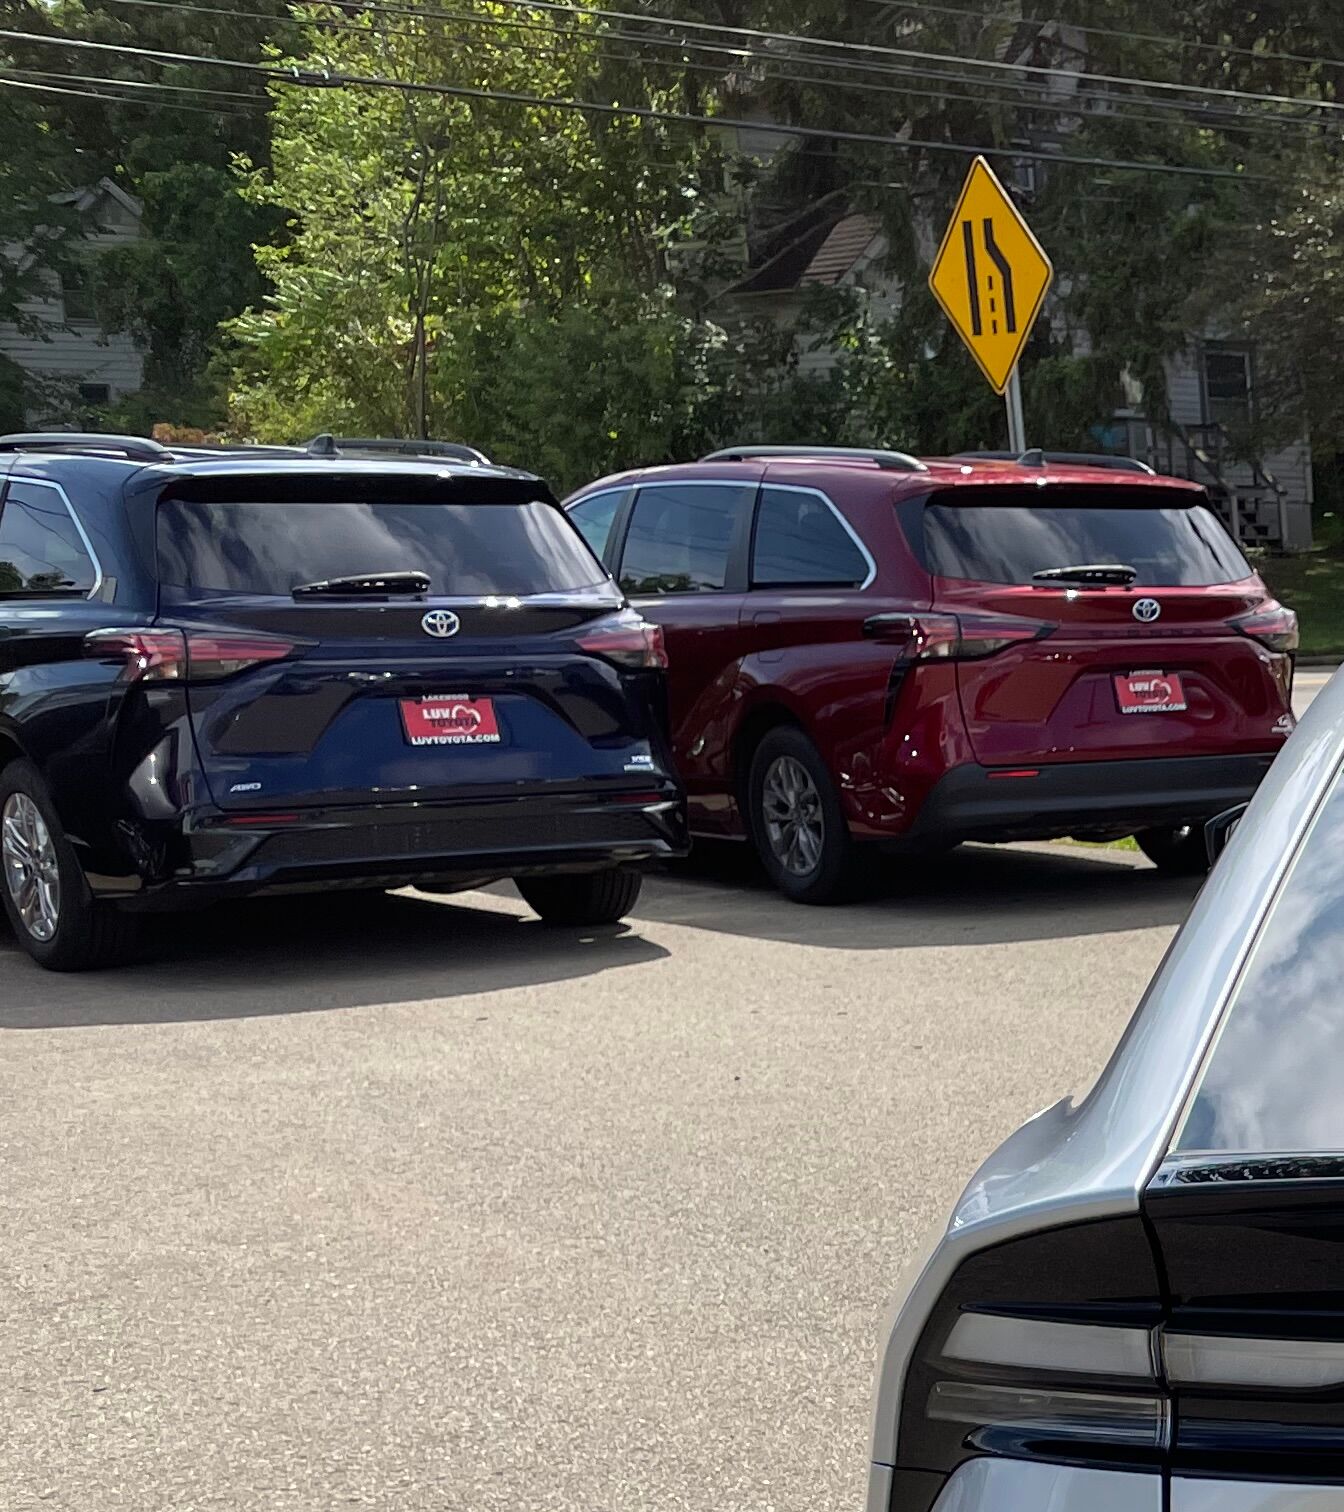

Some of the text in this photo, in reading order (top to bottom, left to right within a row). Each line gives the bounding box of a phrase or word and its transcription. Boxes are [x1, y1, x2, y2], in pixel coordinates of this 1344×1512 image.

[422, 707, 451, 720] LUV
[429, 717, 480, 729] TOYOTA
[411, 733, 501, 746] LUVTOYOTA.COM
